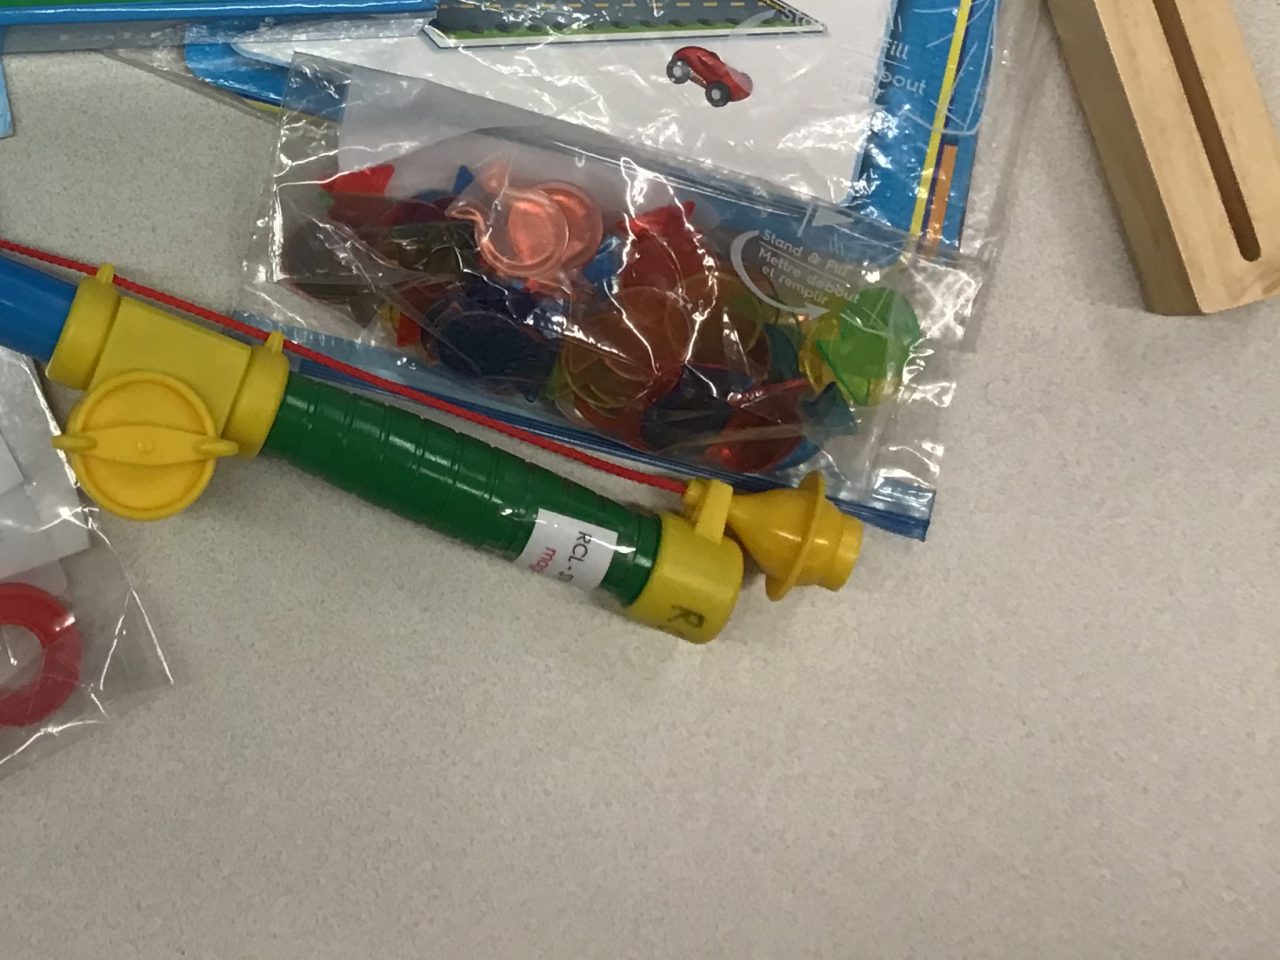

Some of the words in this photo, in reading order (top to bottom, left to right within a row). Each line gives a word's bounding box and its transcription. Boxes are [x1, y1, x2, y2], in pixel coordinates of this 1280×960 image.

[758, 247, 802, 277] Mettre
[762, 228, 804, 257] Stand
[808, 252, 820, 264] &
